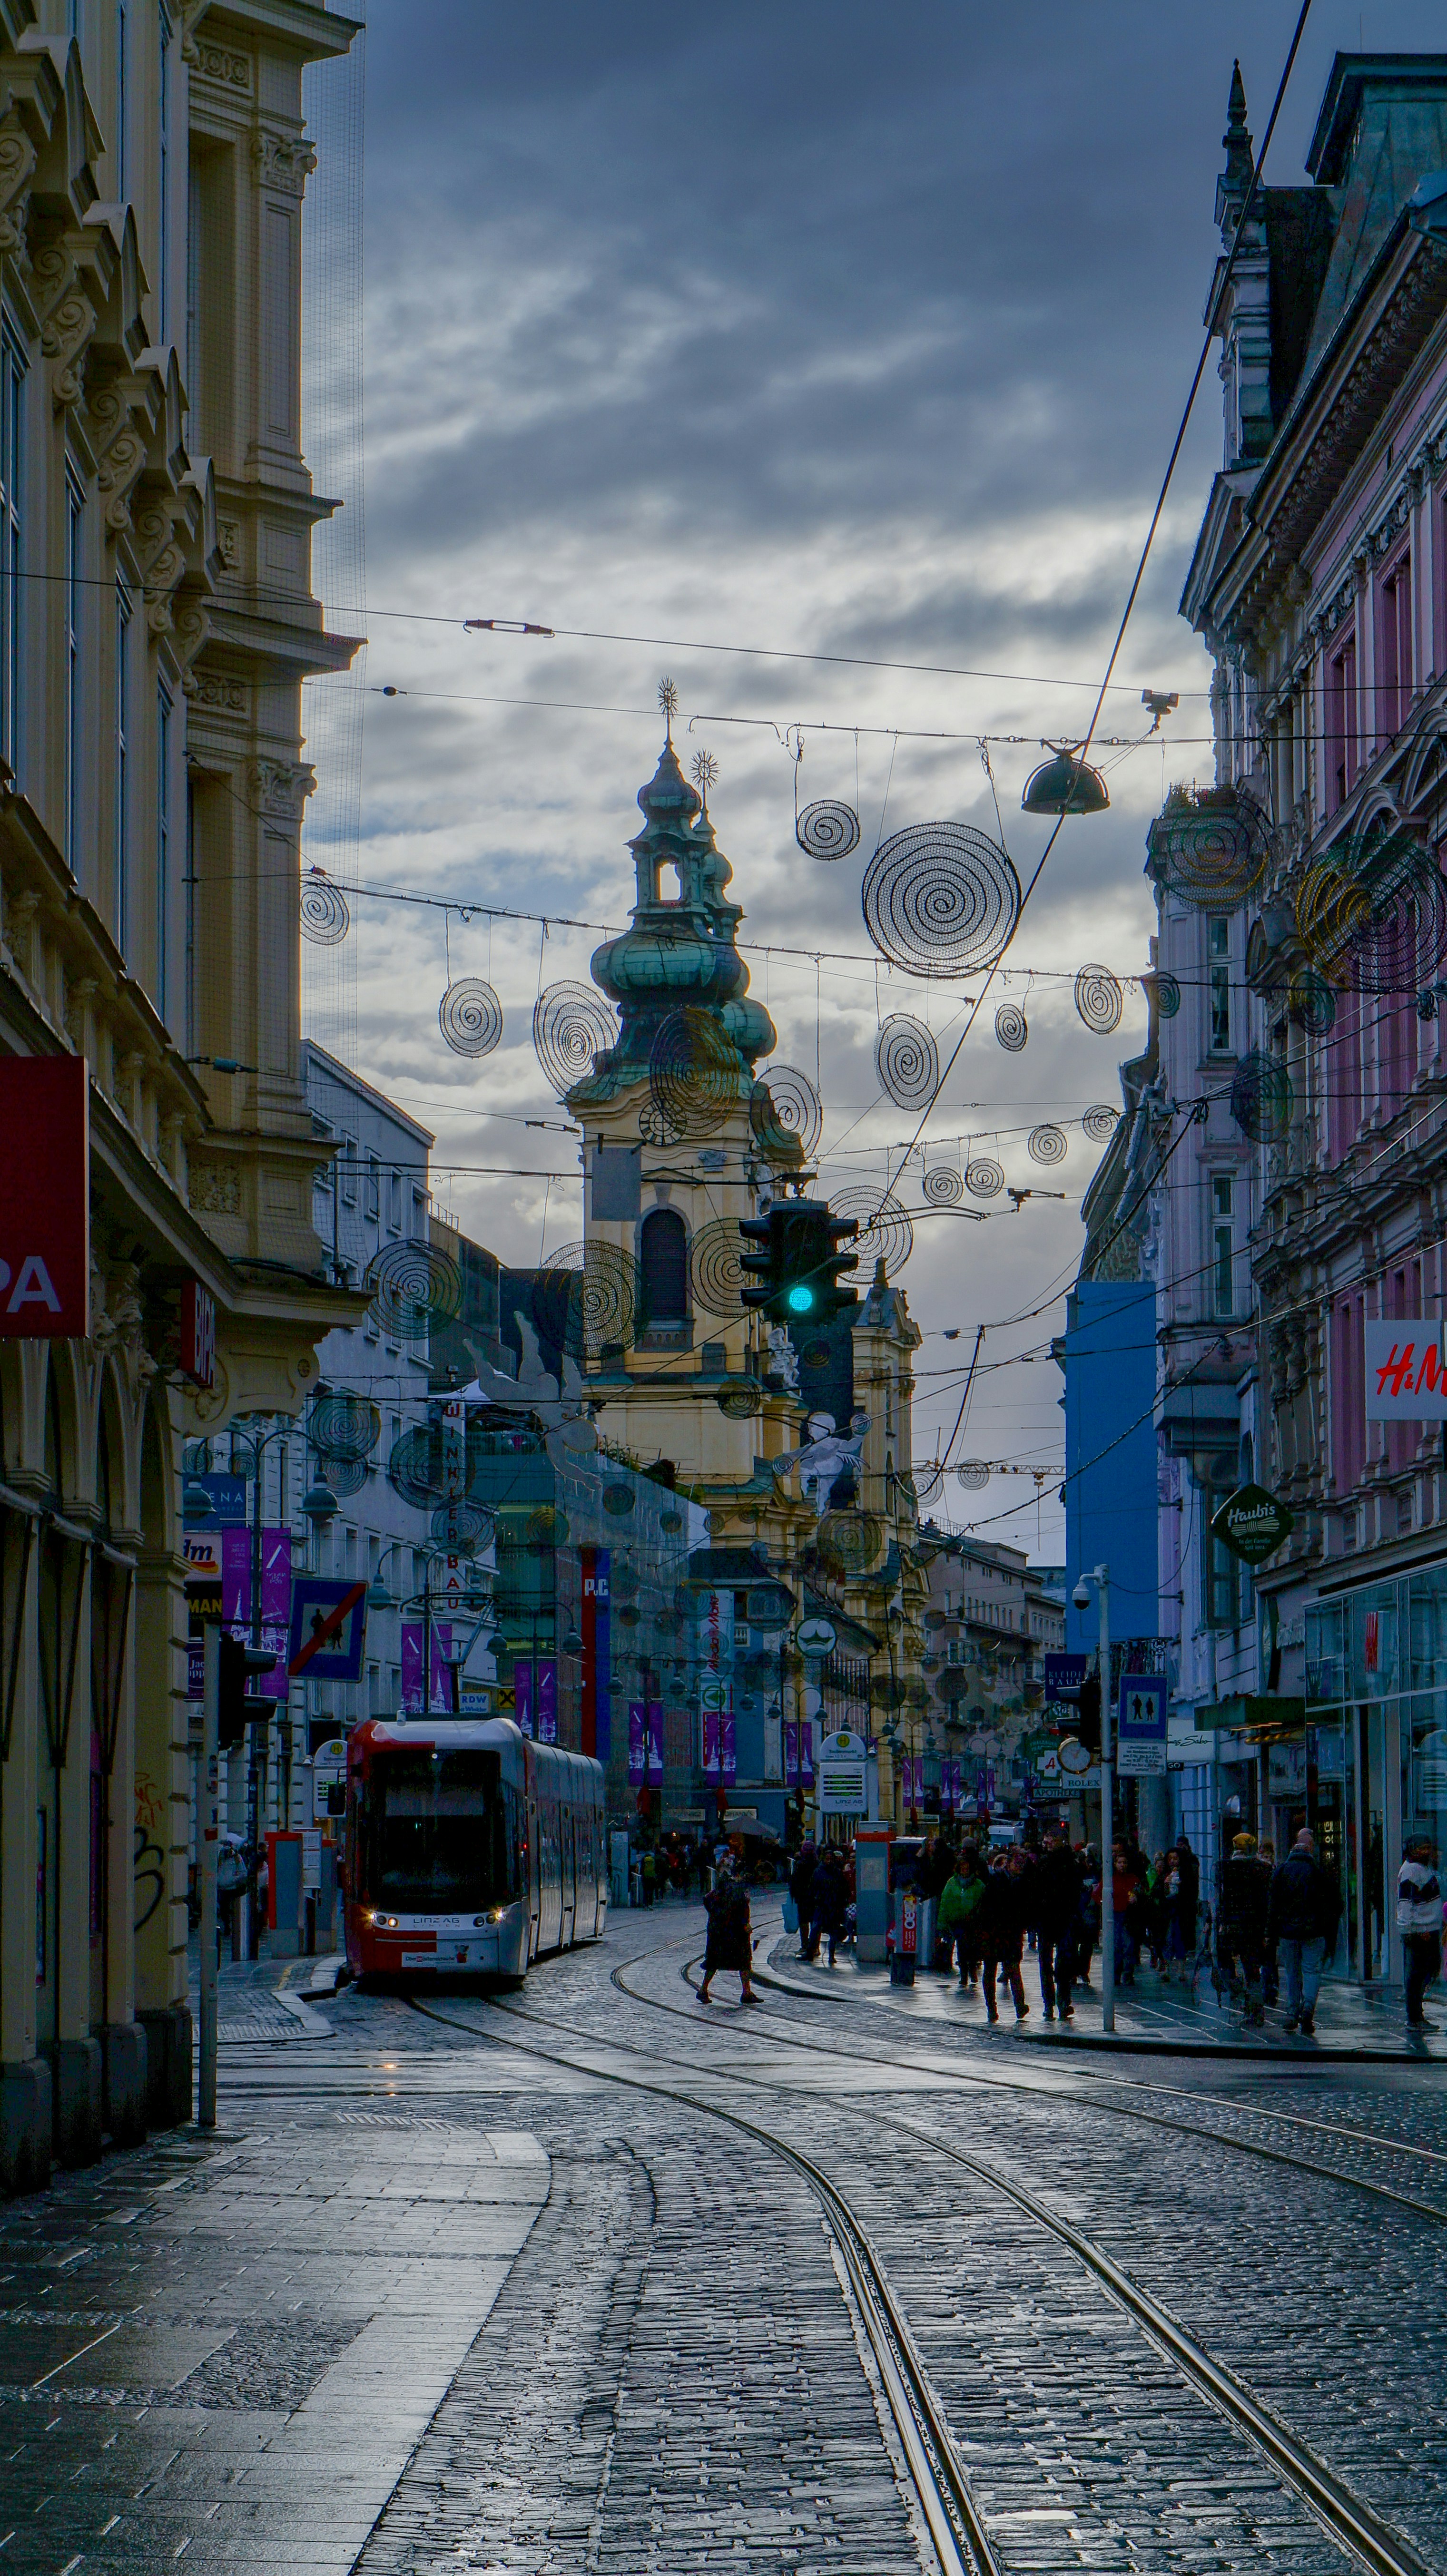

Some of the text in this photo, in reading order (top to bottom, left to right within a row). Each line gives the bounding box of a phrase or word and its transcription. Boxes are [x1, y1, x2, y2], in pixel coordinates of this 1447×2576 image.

[1376, 1343, 1447, 1397] H&M
[1227, 1503, 1276, 1528] Haubis
[462, 1695, 486, 1704] RDW
[1180, 1734, 1213, 1746] Sabo
